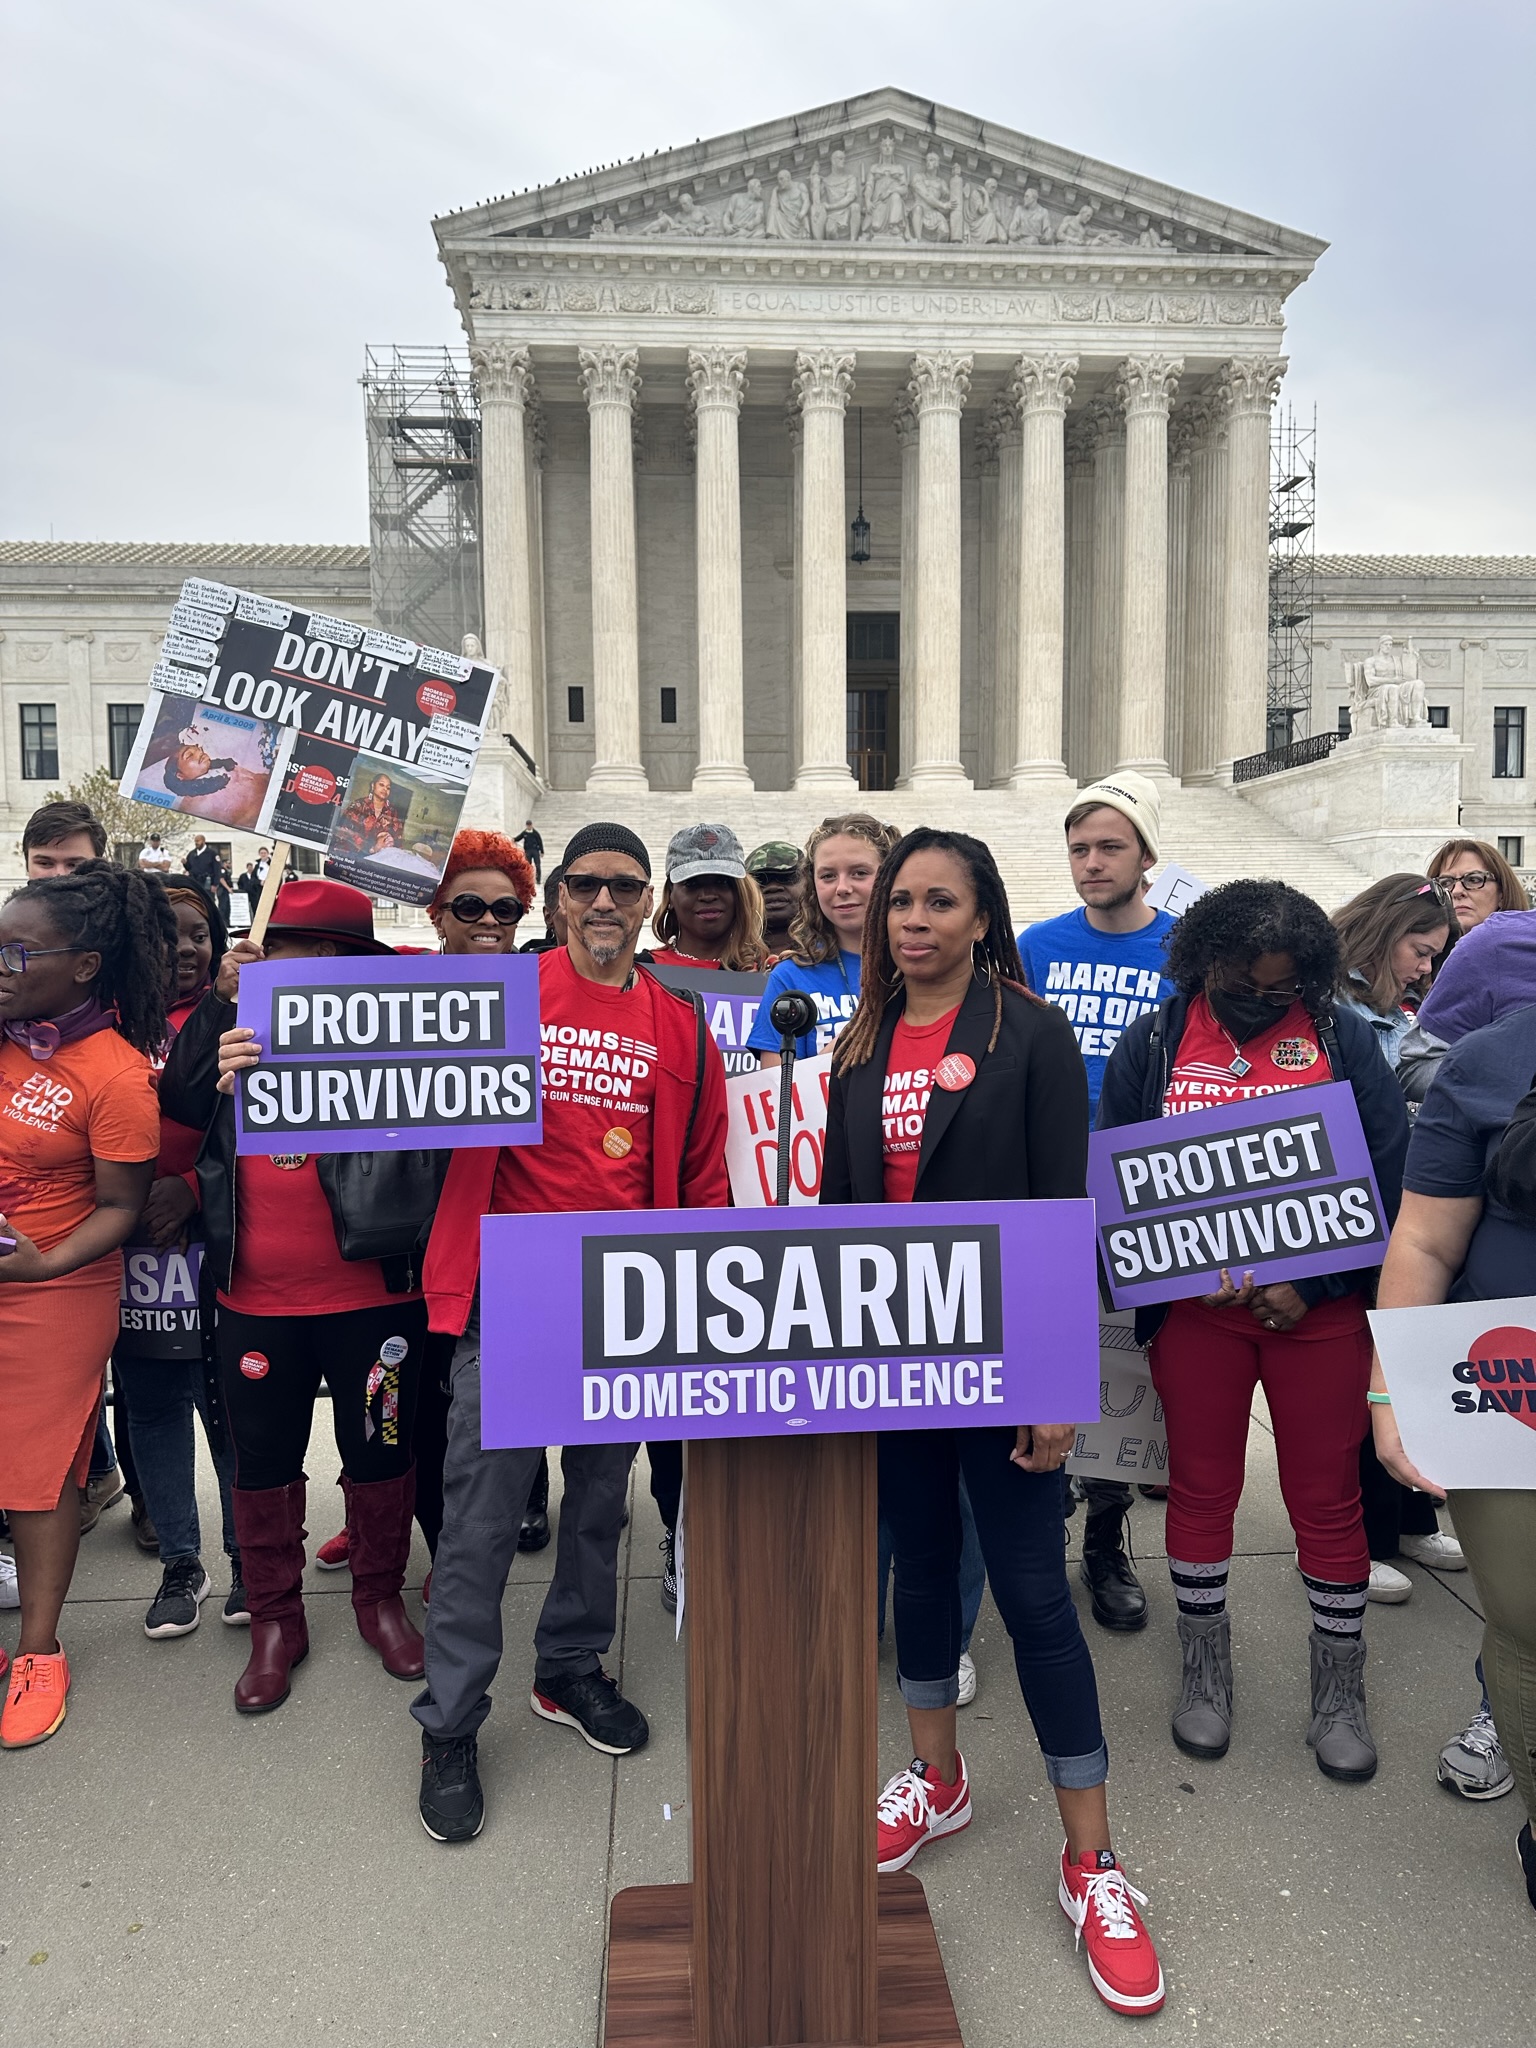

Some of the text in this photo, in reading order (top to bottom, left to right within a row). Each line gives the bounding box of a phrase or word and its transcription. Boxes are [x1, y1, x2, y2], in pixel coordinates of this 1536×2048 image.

[732, 292, 1037, 315] EQUAL JUSTICE UNDER LAW
[274, 631, 399, 699] DON'T
[421, 691, 449, 703] DEMAND
[423, 686, 443, 696] MOMS
[202, 665, 430, 762] LOOK AWAY
[202, 711, 223, 722] April
[232, 718, 255, 730] 2009
[298, 781, 323, 793] ACTION
[300, 777, 328, 789] DEMAND
[301, 772, 322, 782] MOMS
[137, 790, 171, 807] Tavon
[338, 863, 356, 871] mother
[356, 868, 373, 876] should
[1046, 962, 1160, 999] MARCH
[278, 990, 500, 1046] PROTECT
[540, 1024, 619, 1050] MOMS
[1277, 1041, 1300, 1049] IT'S
[541, 1045, 649, 1078] DEMAND
[1275, 1058, 1312, 1066] GUNS
[1276, 1049, 1301, 1057] THE
[23, 1072, 73, 1106] END
[247, 1063, 531, 1125] SURVIVORS
[11, 1089, 65, 1121] GUN
[550, 1090, 570, 1102] GUN
[572, 1093, 602, 1107] SENSE
[603, 1098, 613, 1109] IN
[615, 1101, 649, 1114] AMERICA
[743, 1089, 776, 1135] IF
[3, 1105, 59, 1133] VIOLENCE
[890, 1141, 918, 1152] SENSE
[273, 1155, 303, 1165] GUNS
[1118, 1121, 1320, 1206] PROTECT
[1109, 1186, 1376, 1279] SURVIVORS
[602, 1241, 983, 1357] DISARM
[582, 1360, 1004, 1421] DOMESTIC VIOLENCE
